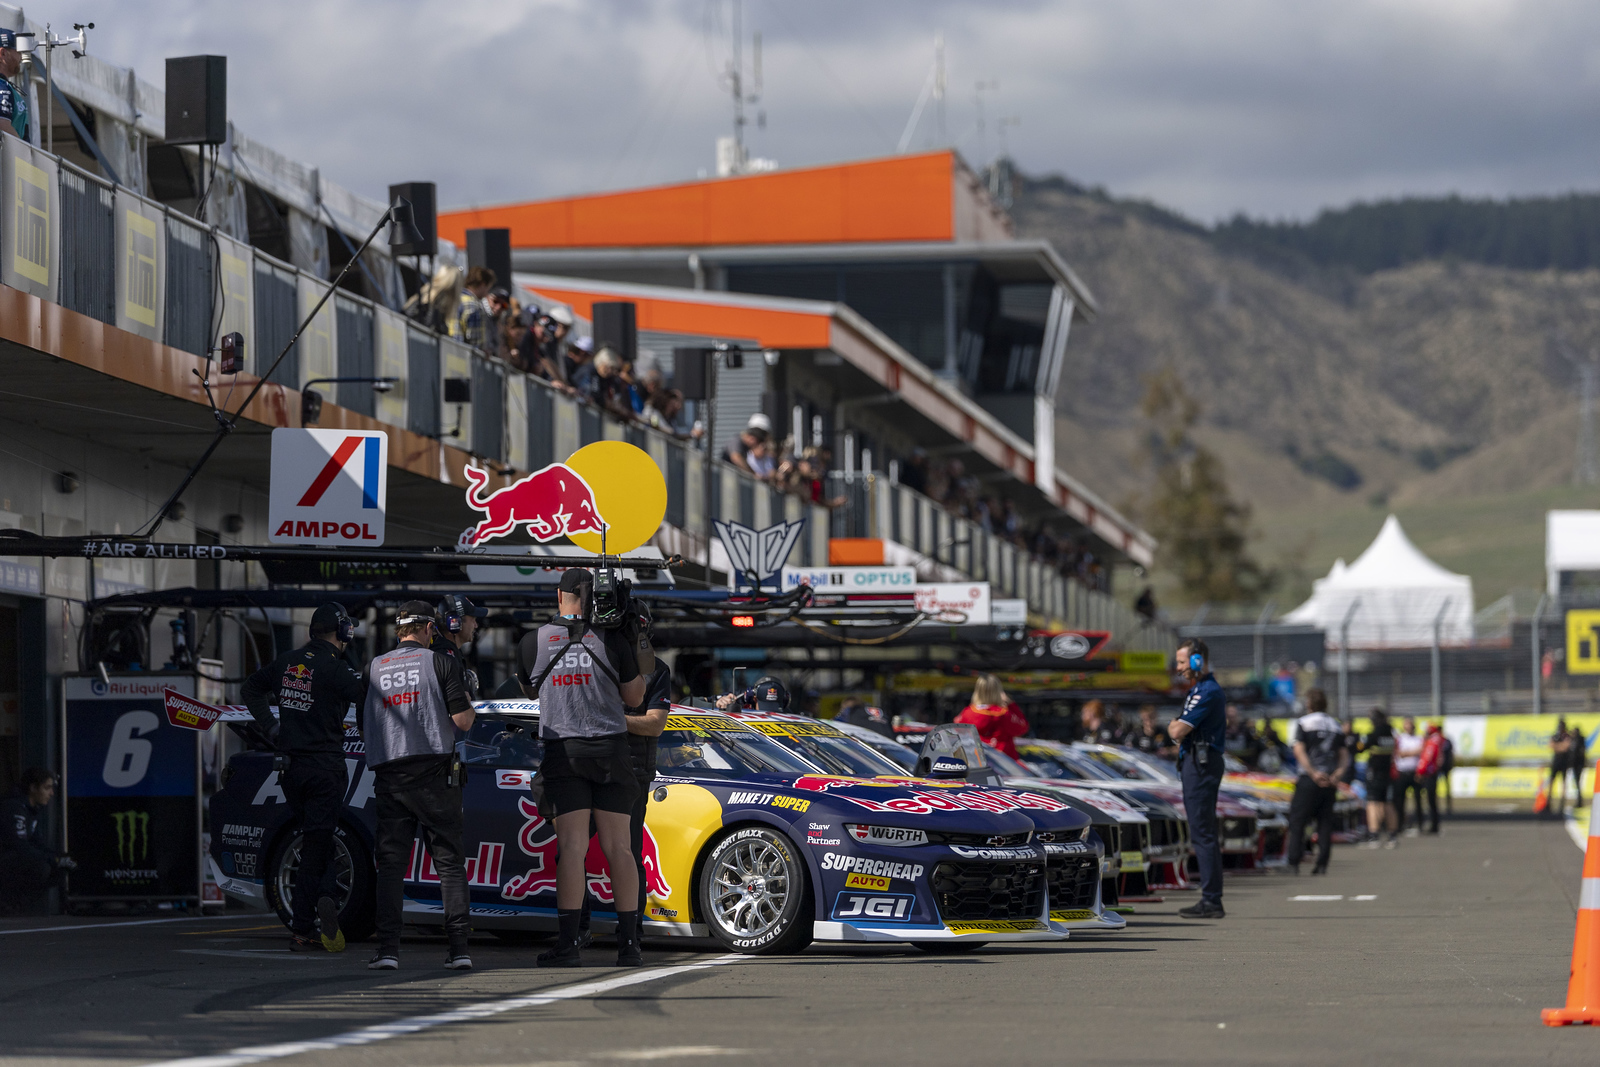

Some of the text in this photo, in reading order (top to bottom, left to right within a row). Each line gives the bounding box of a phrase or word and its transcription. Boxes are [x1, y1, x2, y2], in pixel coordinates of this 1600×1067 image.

[274, 520, 377, 540] AMPOL
[82, 541, 227, 560] #AIR ALLIED
[853, 572, 913, 586] OPTUS
[380, 669, 420, 691] 635
[552, 673, 592, 687] HOST
[110, 683, 128, 694] Air
[280, 688, 315, 703] AMPOL
[382, 691, 420, 709] HOST
[488, 702, 517, 710] BROC
[166, 695, 218, 722] SUPERCHEAP
[178, 711, 197, 724] AUTO
[102, 709, 160, 789] 6
[933, 762, 967, 770] ACDelco
[727, 792, 811, 813] MAKE IT SUPER
[226, 824, 266, 842] AMPLIFY
[807, 829, 823, 837] and
[808, 822, 831, 831] Shaw
[221, 834, 247, 846] Premium
[712, 829, 764, 861] SPORT MAXX
[806, 835, 841, 845] Partners
[234, 852, 257, 864] QUAD
[235, 863, 257, 876] LOCK
[820, 852, 924, 882] SUPERCHEAP
[850, 876, 886, 888] AUTO
[658, 907, 679, 918] Repco
[838, 896, 909, 918] JGI
[732, 923, 783, 948] DUNLOP
